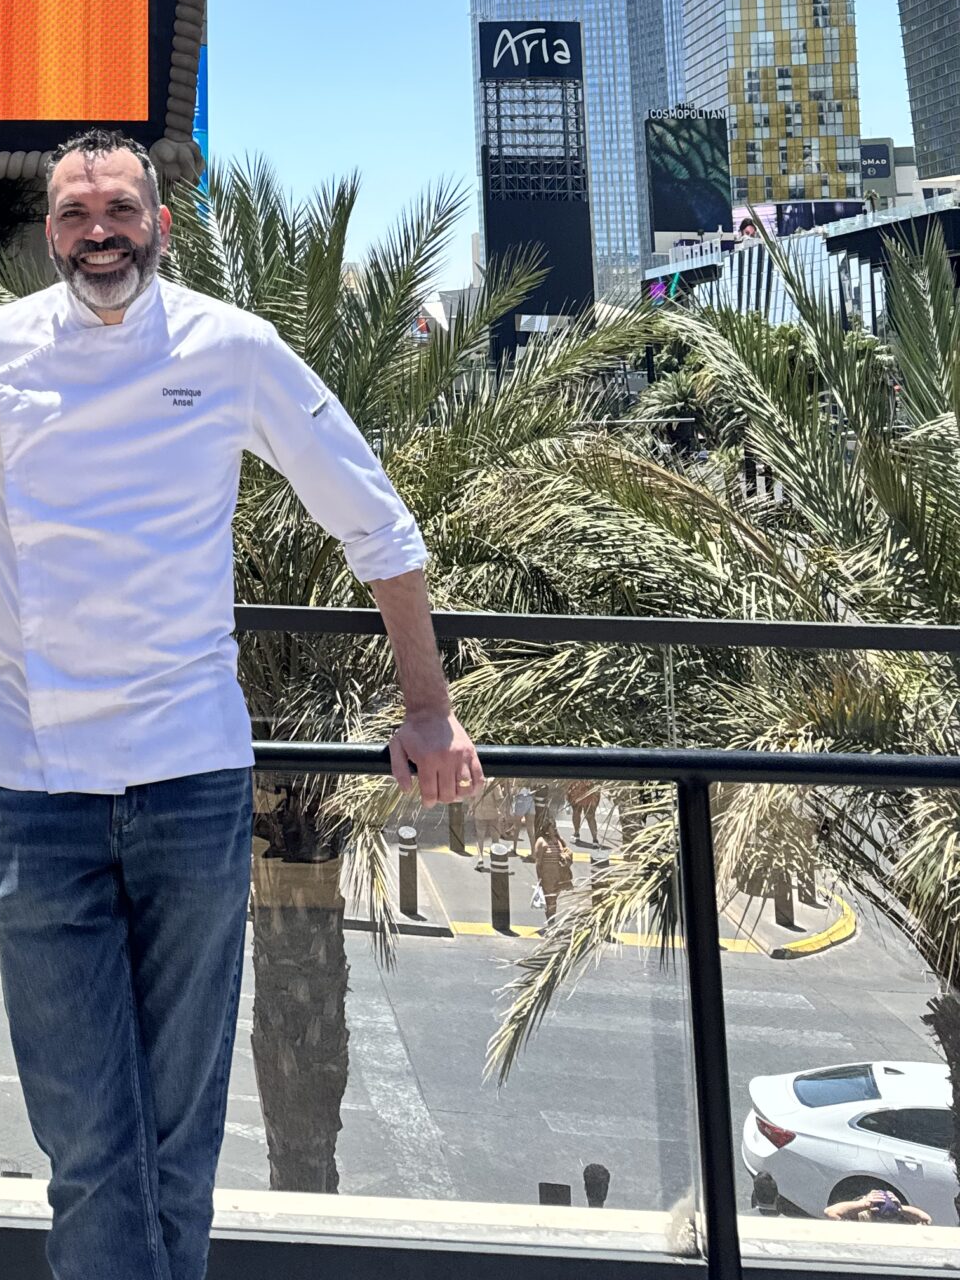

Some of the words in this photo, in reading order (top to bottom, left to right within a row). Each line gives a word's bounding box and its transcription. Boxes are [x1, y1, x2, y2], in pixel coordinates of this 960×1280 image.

[493, 28, 571, 68] Aria
[650, 109, 726, 119] COSMOPOLITAN
[162, 387, 202, 398] Dominique
[172, 398, 194, 407] Ansel
